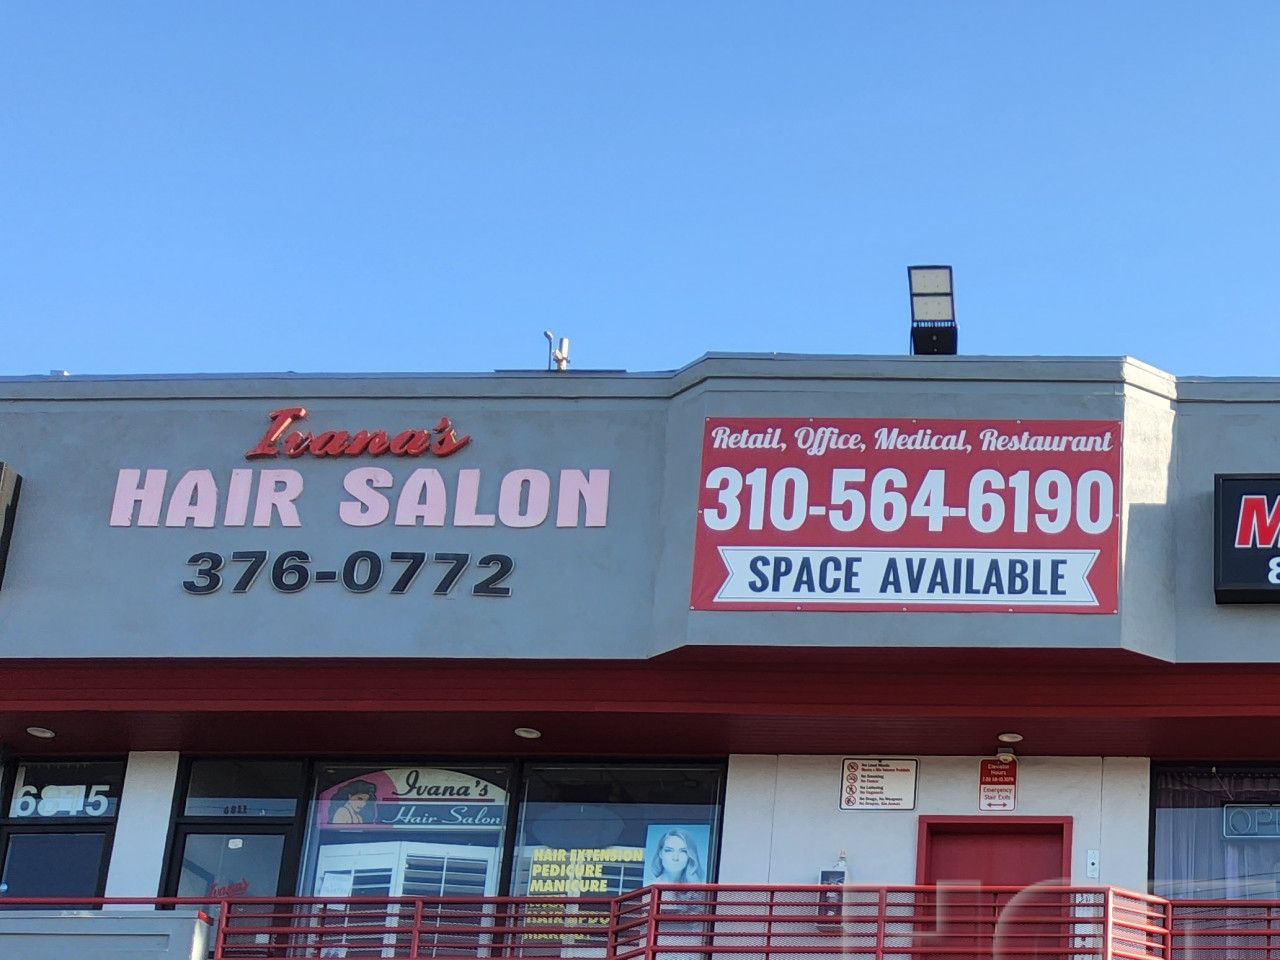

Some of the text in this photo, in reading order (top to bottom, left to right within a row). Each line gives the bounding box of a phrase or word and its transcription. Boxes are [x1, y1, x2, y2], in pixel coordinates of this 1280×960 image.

[245, 407, 471, 459] Ivana's
[711, 426, 1113, 456] Retail, Office, Medical, Restaurant
[110, 467, 610, 528] HAIR SALON
[703, 467, 1114, 534] 310-564-6190
[182, 550, 515, 597] 376-0772
[748, 555, 1068, 596] SPACE AVAILABLE
[392, 770, 489, 797] Ivana's
[382, 805, 502, 825] Hair Salon
[530, 879, 608, 893] MANICURE
[532, 864, 603, 877] PEDICURE
